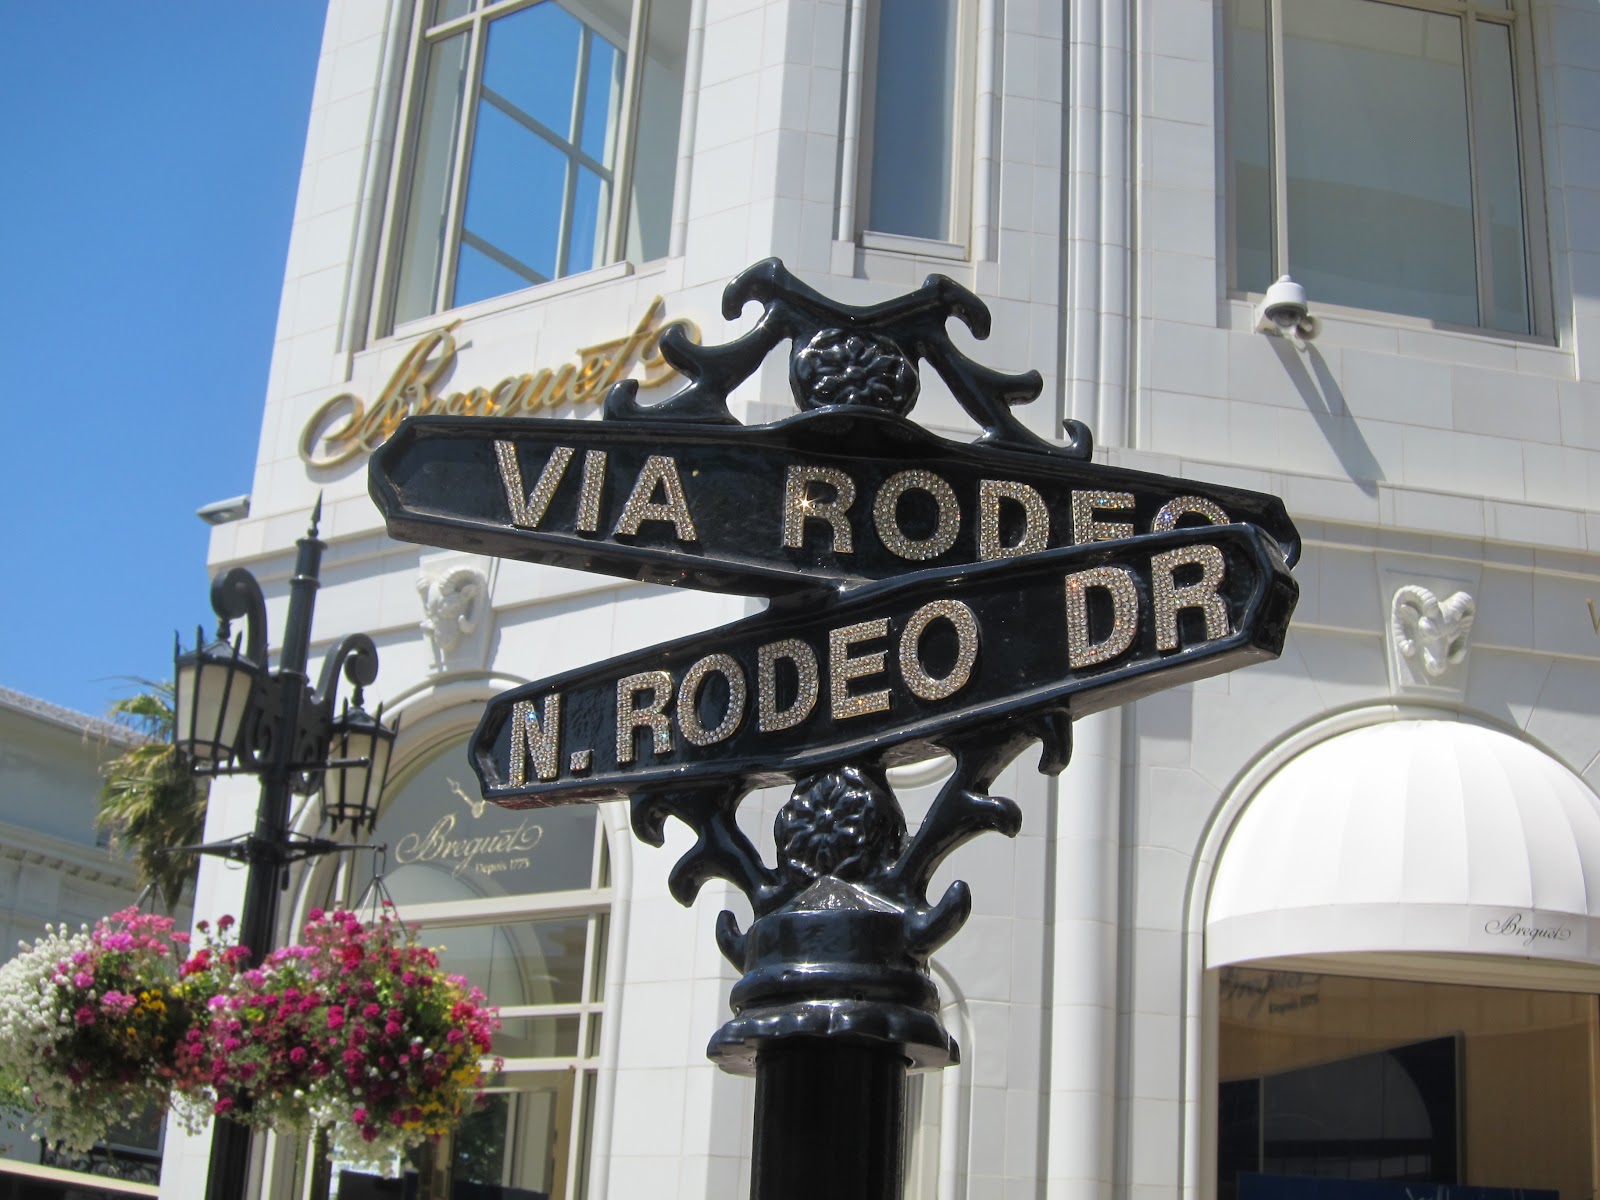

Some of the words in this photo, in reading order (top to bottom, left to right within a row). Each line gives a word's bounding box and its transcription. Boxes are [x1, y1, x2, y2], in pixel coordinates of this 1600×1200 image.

[494, 440, 698, 542] VIA
[508, 693, 592, 787] N.
[615, 599, 979, 764] RODEO
[1064, 544, 1230, 670] DR
[395, 813, 544, 878] Breguet
[1484, 912, 1572, 946] Breguet
